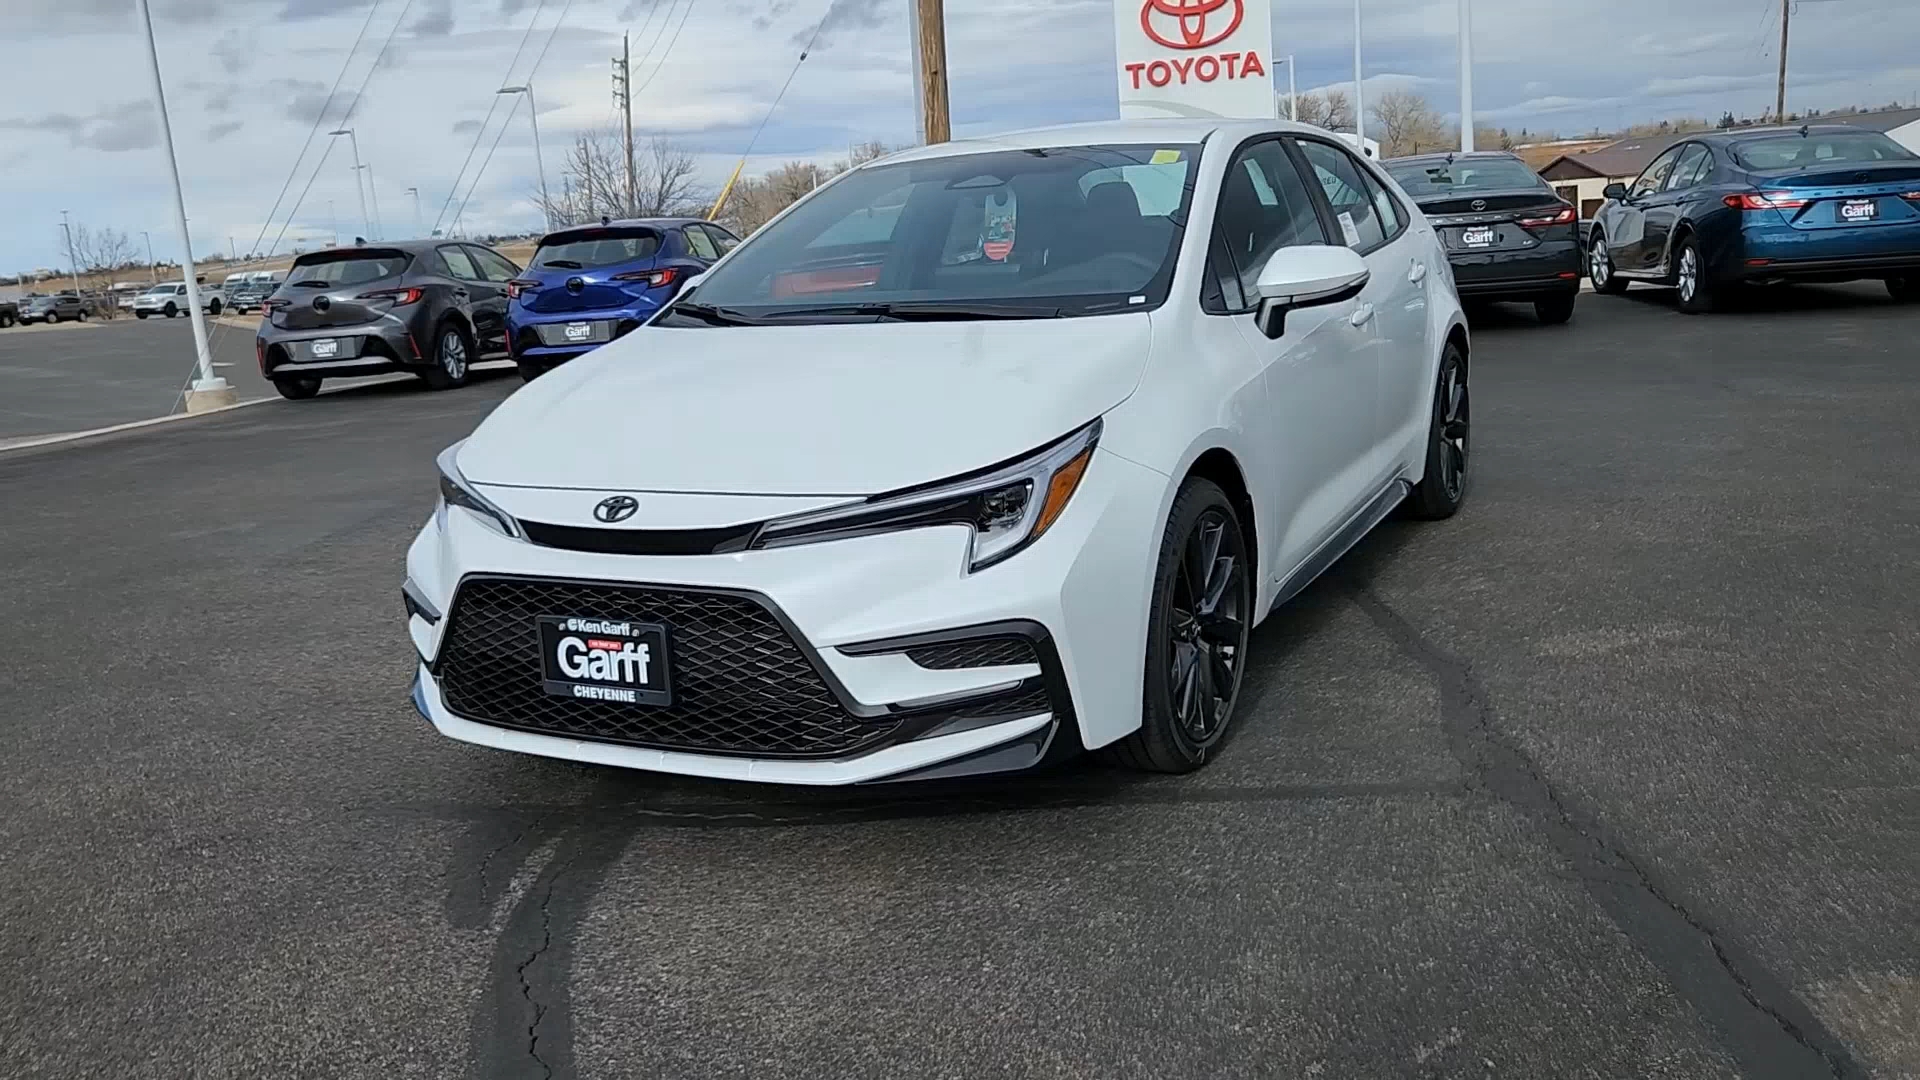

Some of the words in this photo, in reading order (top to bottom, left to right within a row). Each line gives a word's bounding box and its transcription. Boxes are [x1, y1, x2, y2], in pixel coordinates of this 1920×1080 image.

[1125, 51, 1265, 89] TOYOTA
[1842, 203, 1875, 217] Garff
[1463, 230, 1494, 244] Garff
[577, 619, 601, 634] Ken
[601, 620, 630, 636] Garff
[557, 636, 650, 684] Garff
[573, 685, 637, 702] CHEYENNE
